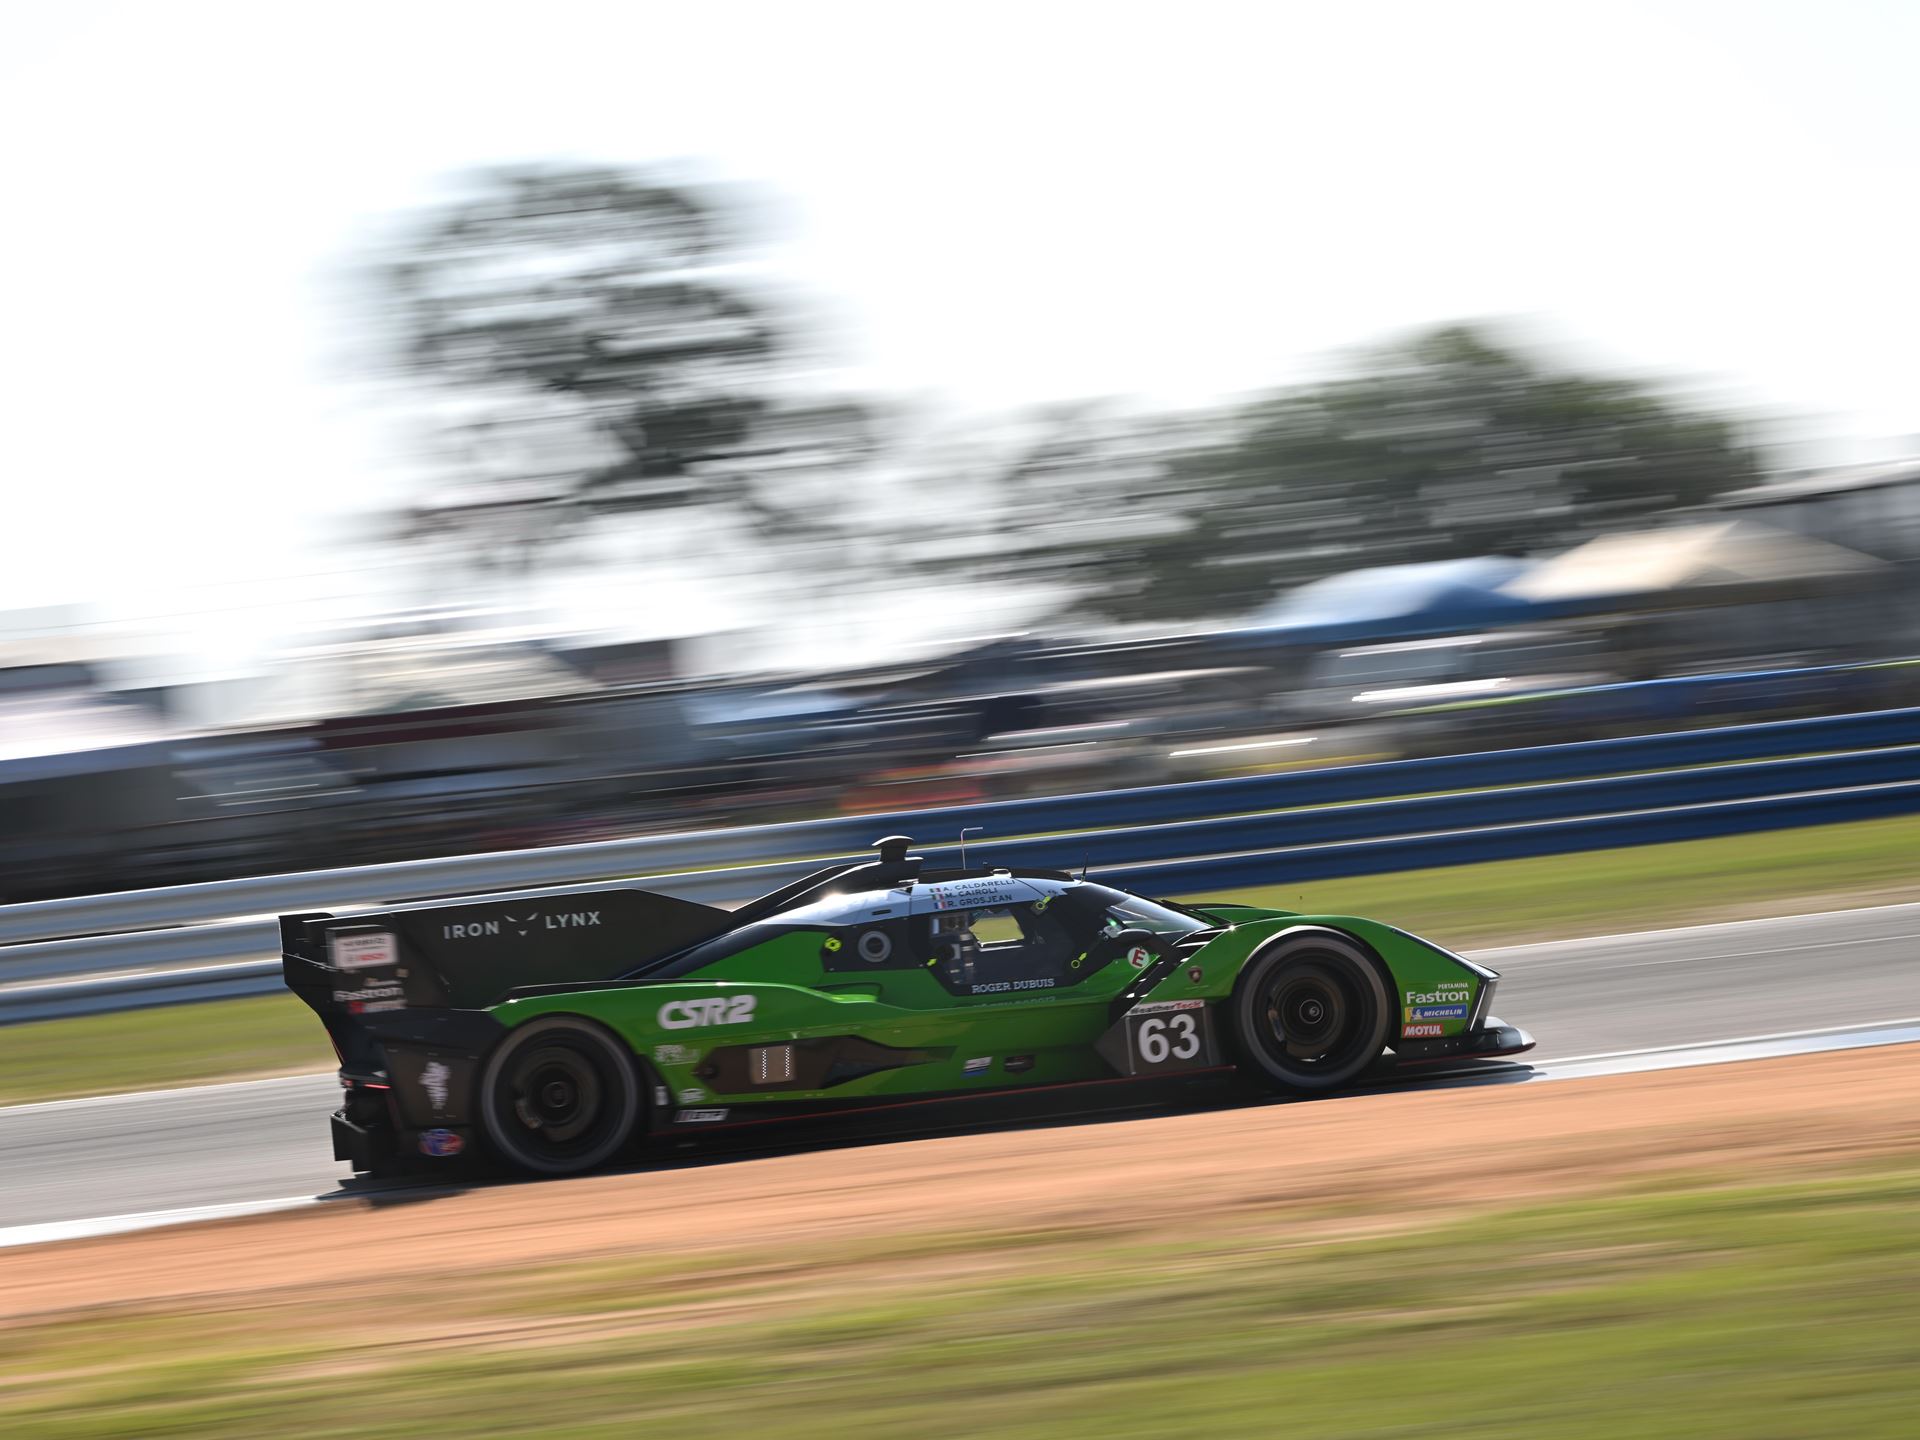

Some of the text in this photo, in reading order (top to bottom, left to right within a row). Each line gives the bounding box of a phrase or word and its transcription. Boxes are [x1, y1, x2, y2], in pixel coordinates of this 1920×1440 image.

[954, 879, 1015, 890] CALDARELLI
[959, 887, 998, 896] CAIROLI
[960, 894, 1012, 906] GROSJEAN
[443, 906, 600, 940] IRON LYNX
[972, 978, 1055, 994] ROGER DUBUIS
[1438, 982, 1468, 990] PERTAMINA
[1406, 991, 1469, 1004] Fastron
[658, 994, 756, 1030] CSR2
[1424, 1008, 1462, 1017] MICHELIN
[1404, 1025, 1442, 1036] MOTUL
[1138, 1014, 1200, 1064] 63
